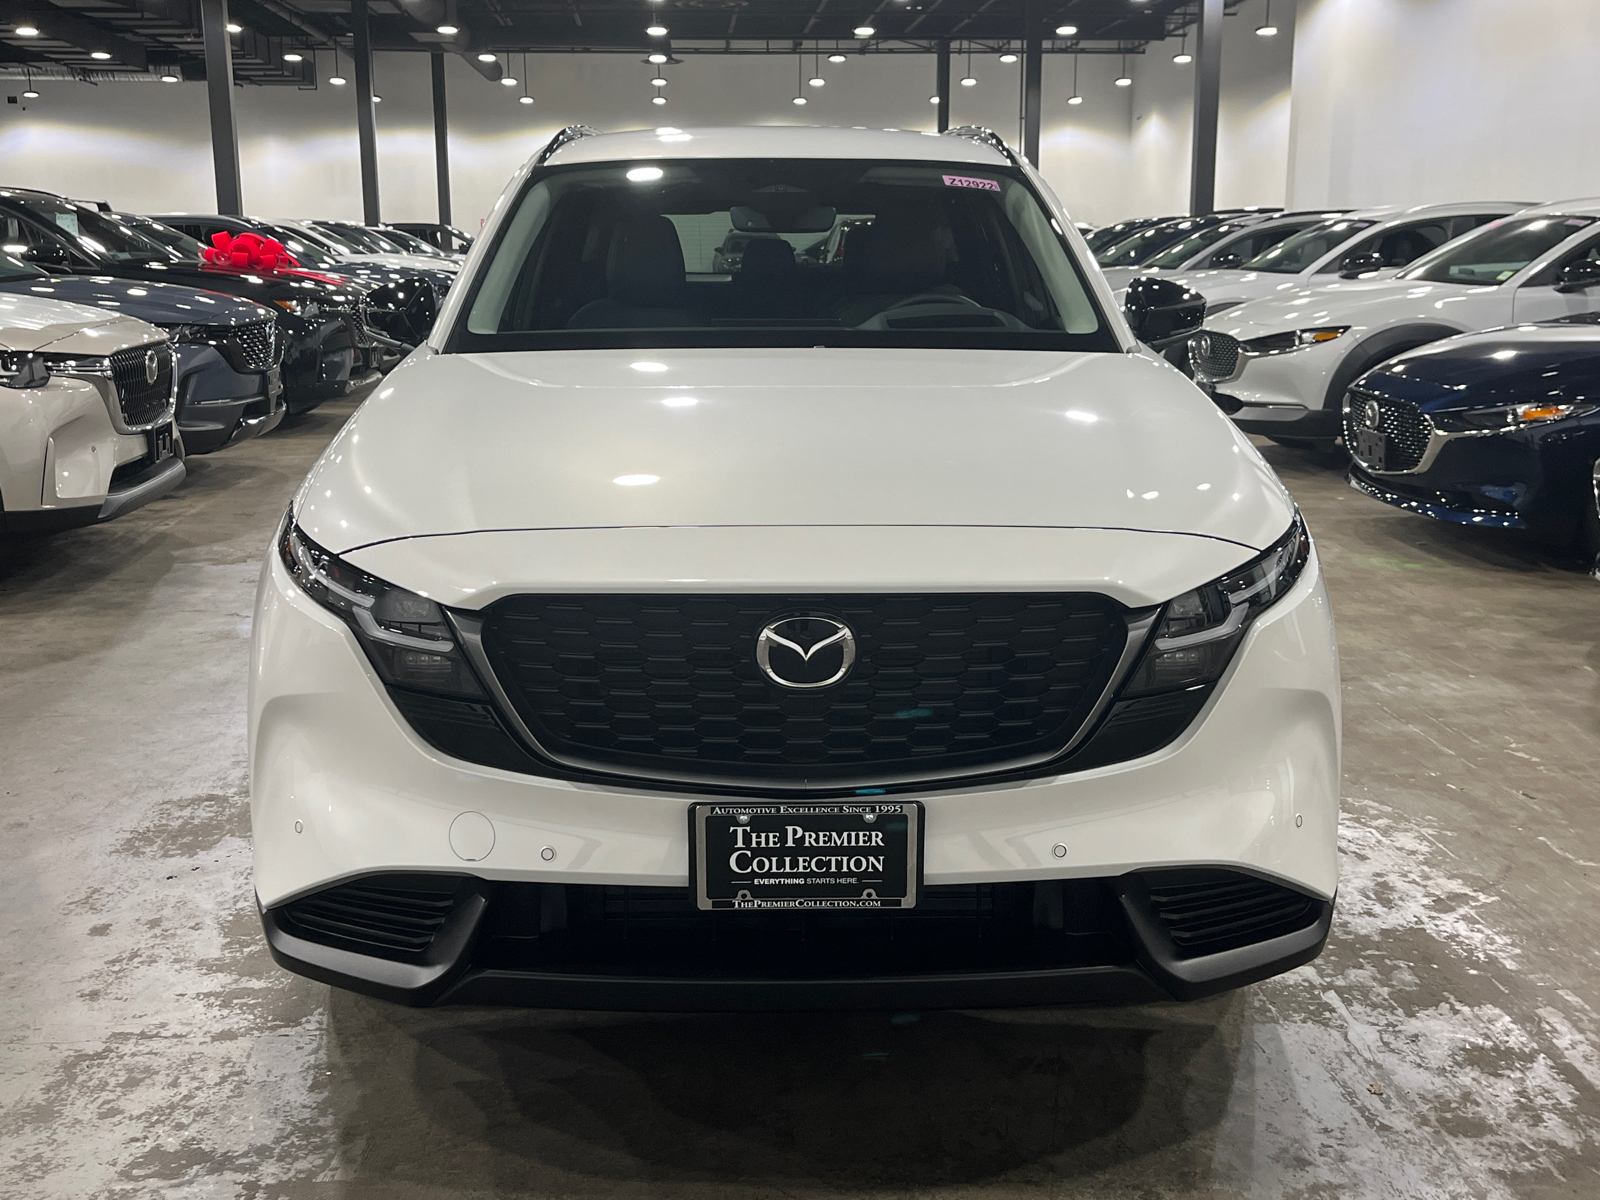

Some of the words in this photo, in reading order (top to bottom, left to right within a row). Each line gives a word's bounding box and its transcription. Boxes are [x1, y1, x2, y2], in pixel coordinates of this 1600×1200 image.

[875, 805, 901, 813] 1995
[729, 826, 781, 848] THE
[785, 825, 885, 847] PREMIER
[729, 850, 885, 874] COLLECTION
